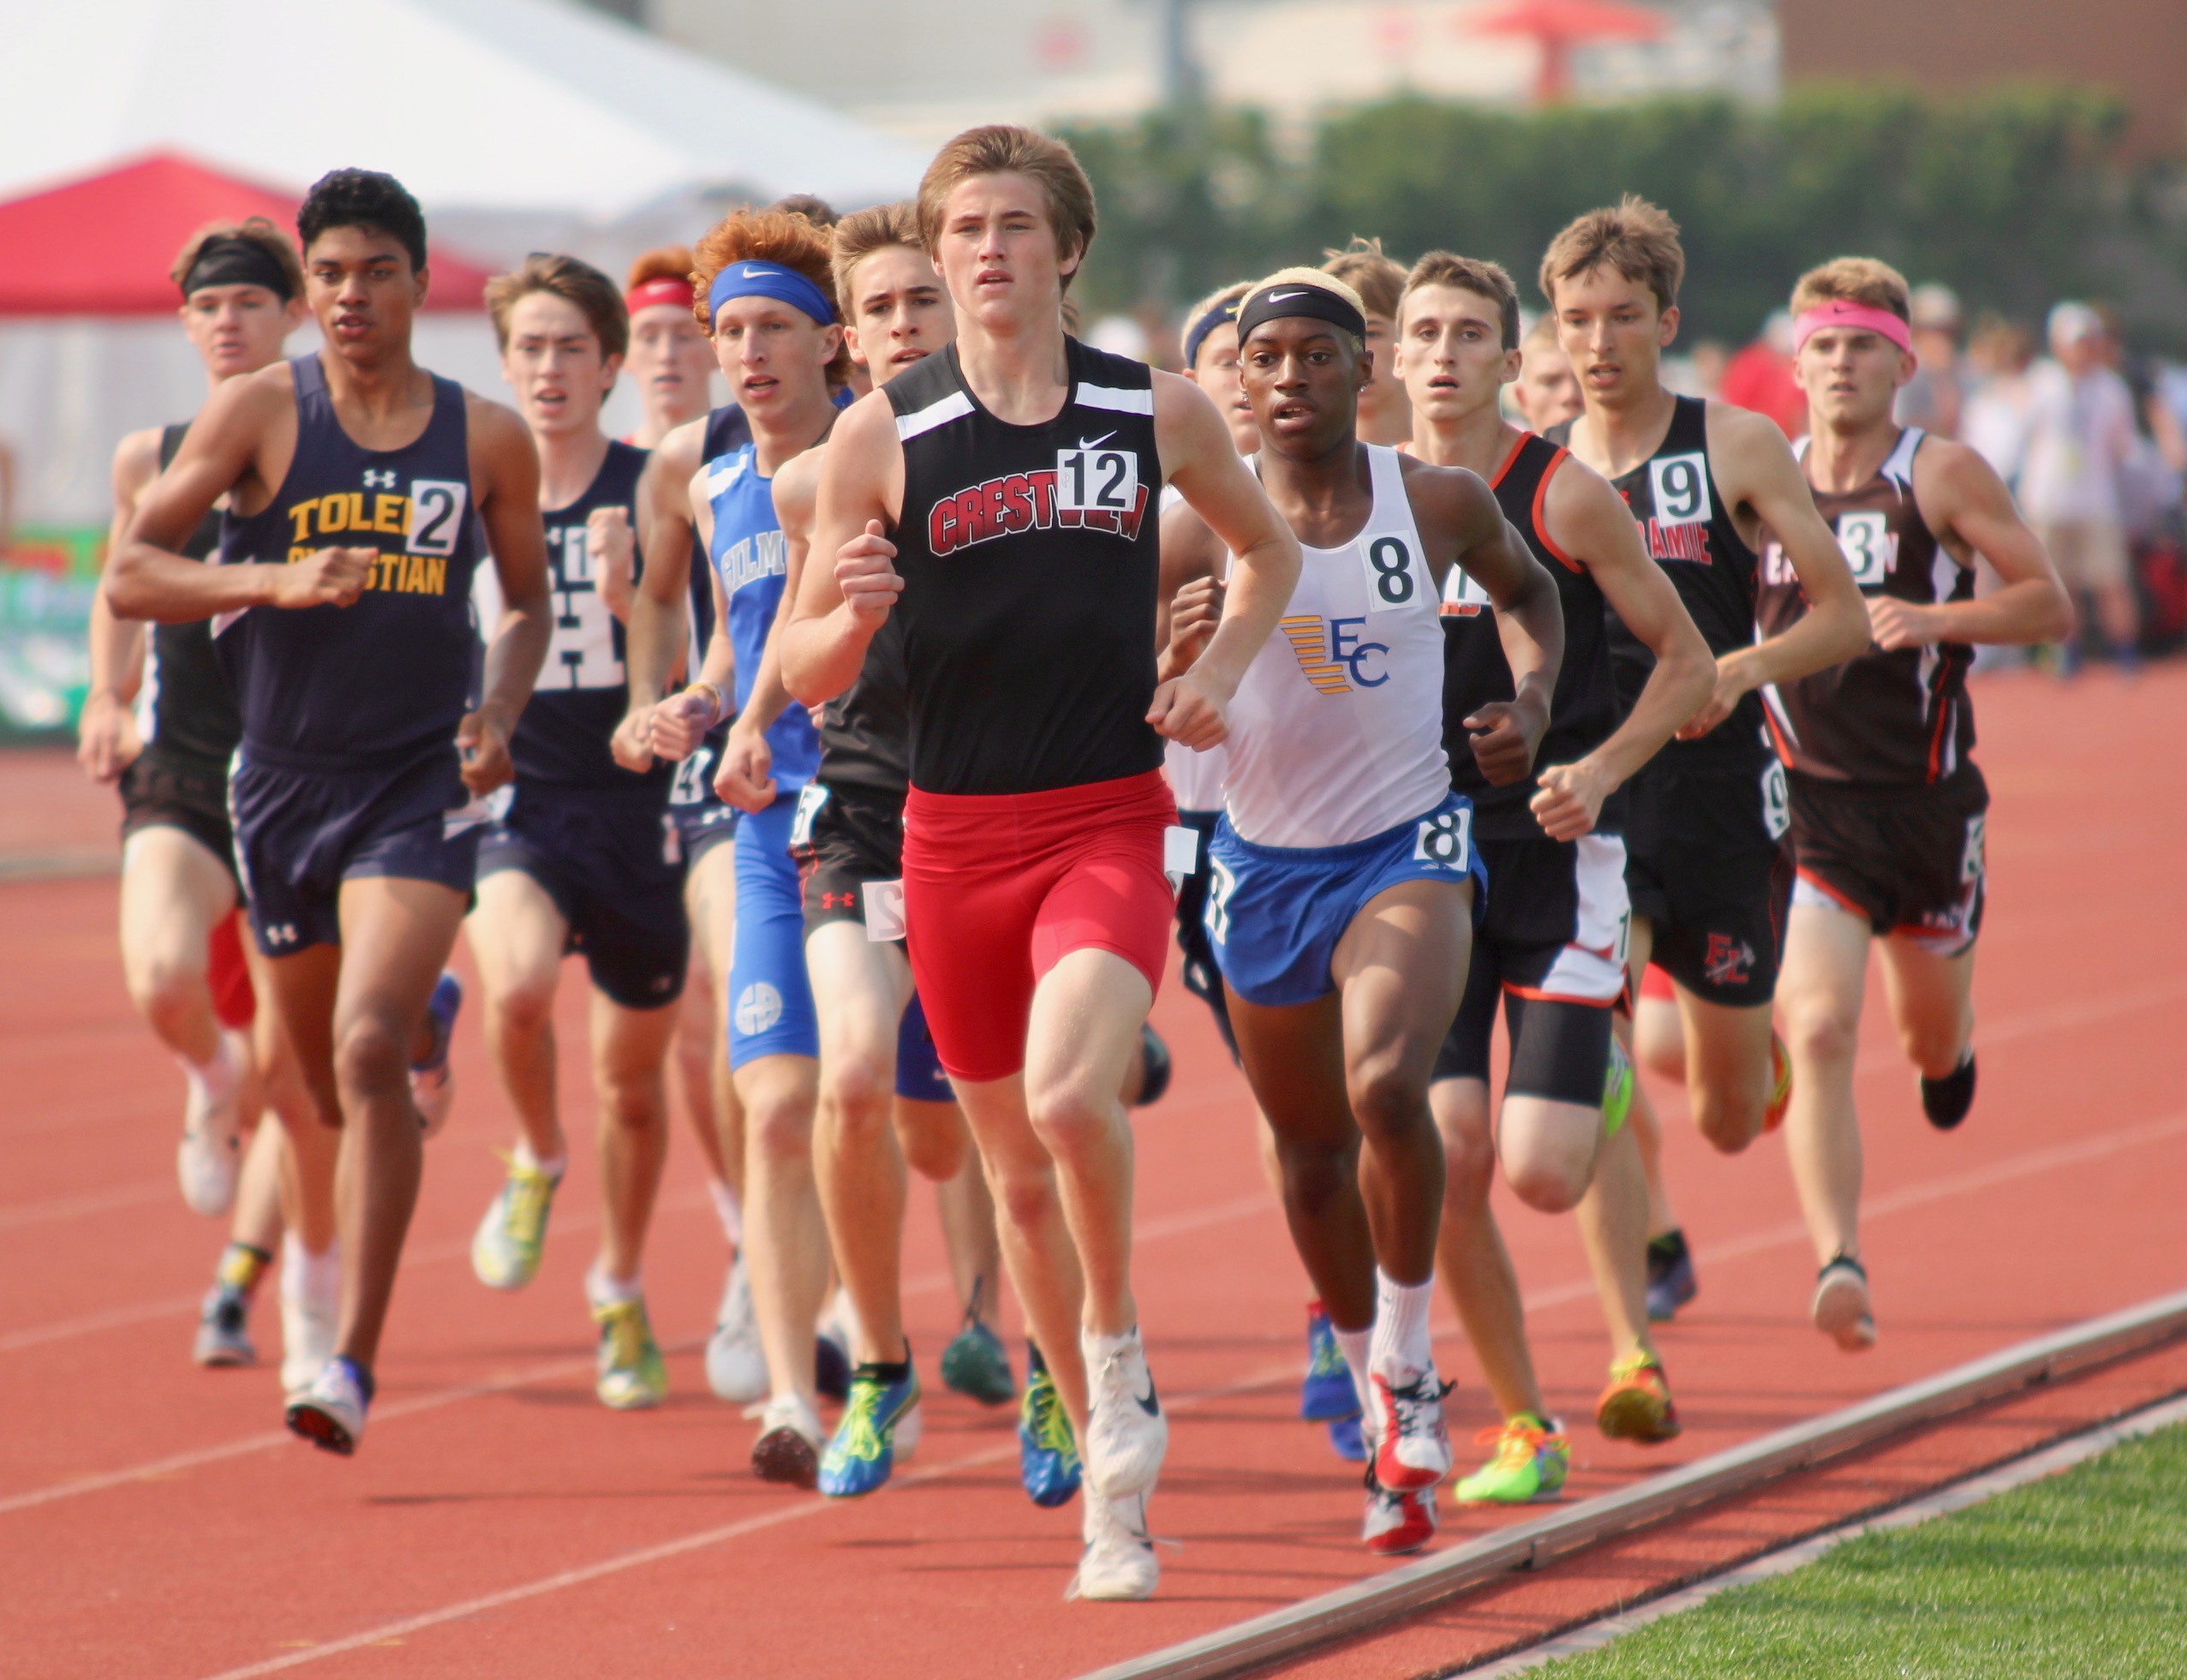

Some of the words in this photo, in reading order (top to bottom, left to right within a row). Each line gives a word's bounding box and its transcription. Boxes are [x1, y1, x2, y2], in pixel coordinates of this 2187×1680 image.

[1065, 452, 1126, 507] 12
[1662, 460, 1702, 517] 9
[288, 492, 413, 543] TOLE
[415, 487, 455, 548] 2
[1636, 516, 1712, 565] AMIE
[720, 529, 786, 601] GILM
[1370, 537, 1414, 603] 8
[1847, 522, 1873, 577] 3
[1330, 614, 1391, 687] EC
[1423, 810, 1461, 864] 8
